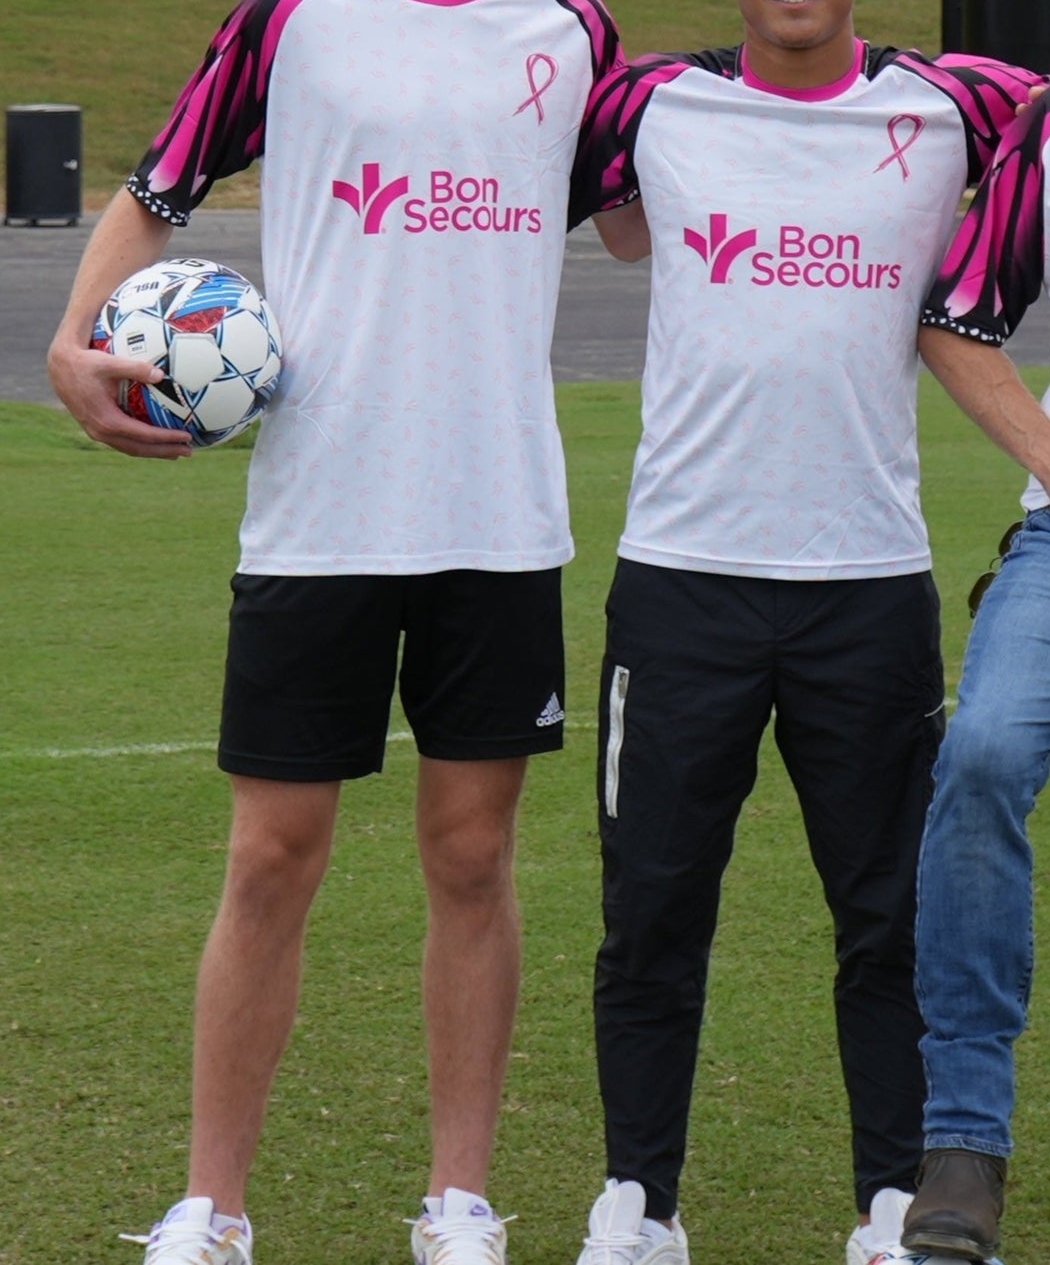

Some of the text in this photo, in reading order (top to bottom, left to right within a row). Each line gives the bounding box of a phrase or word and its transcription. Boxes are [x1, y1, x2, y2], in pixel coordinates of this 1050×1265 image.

[431, 170, 499, 204] Bon
[404, 199, 541, 234] Secours
[780, 225, 861, 260] Bon
[751, 252, 902, 289] Secours
